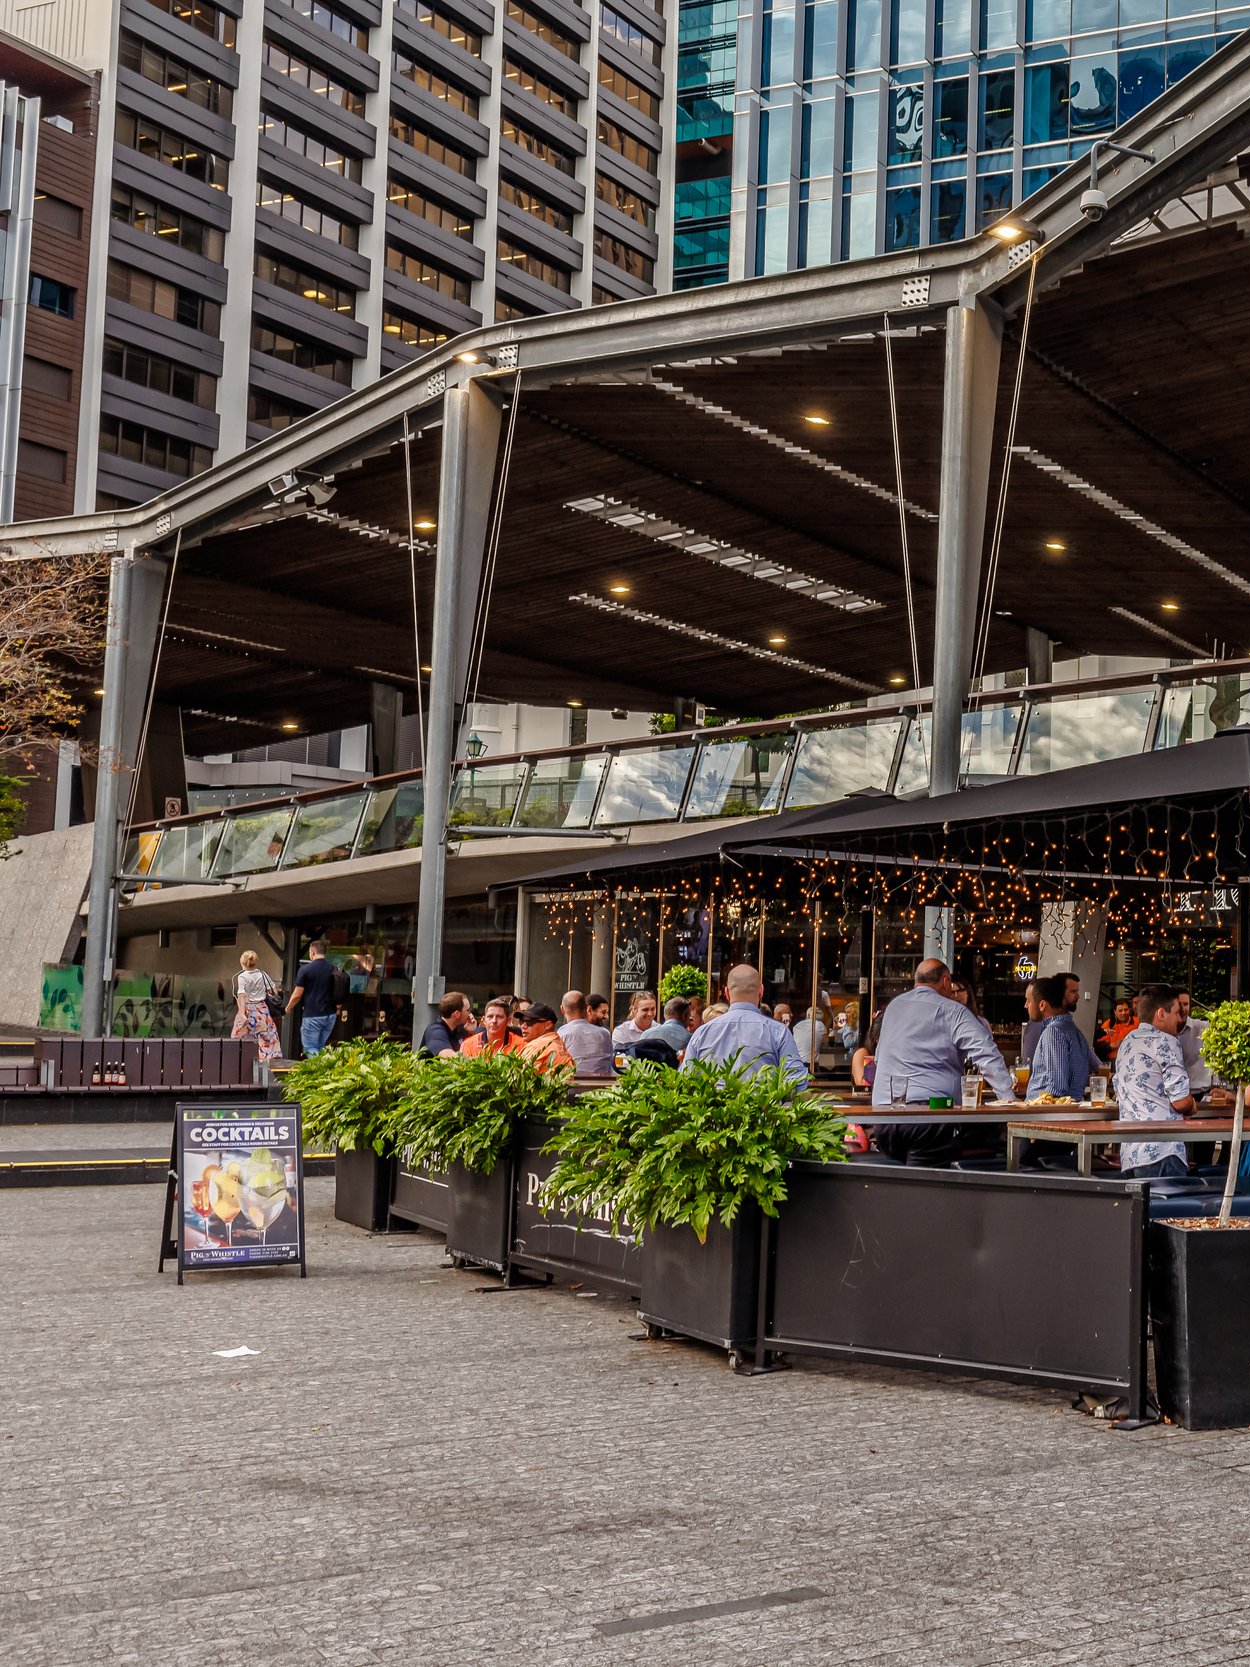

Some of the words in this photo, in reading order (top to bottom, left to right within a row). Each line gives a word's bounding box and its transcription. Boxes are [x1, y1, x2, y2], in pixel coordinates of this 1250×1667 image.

[614, 981, 645, 990] WHISTLE
[190, 1126, 290, 1142] COCKTAILS
[211, 1249, 246, 1257] WHISTLE
